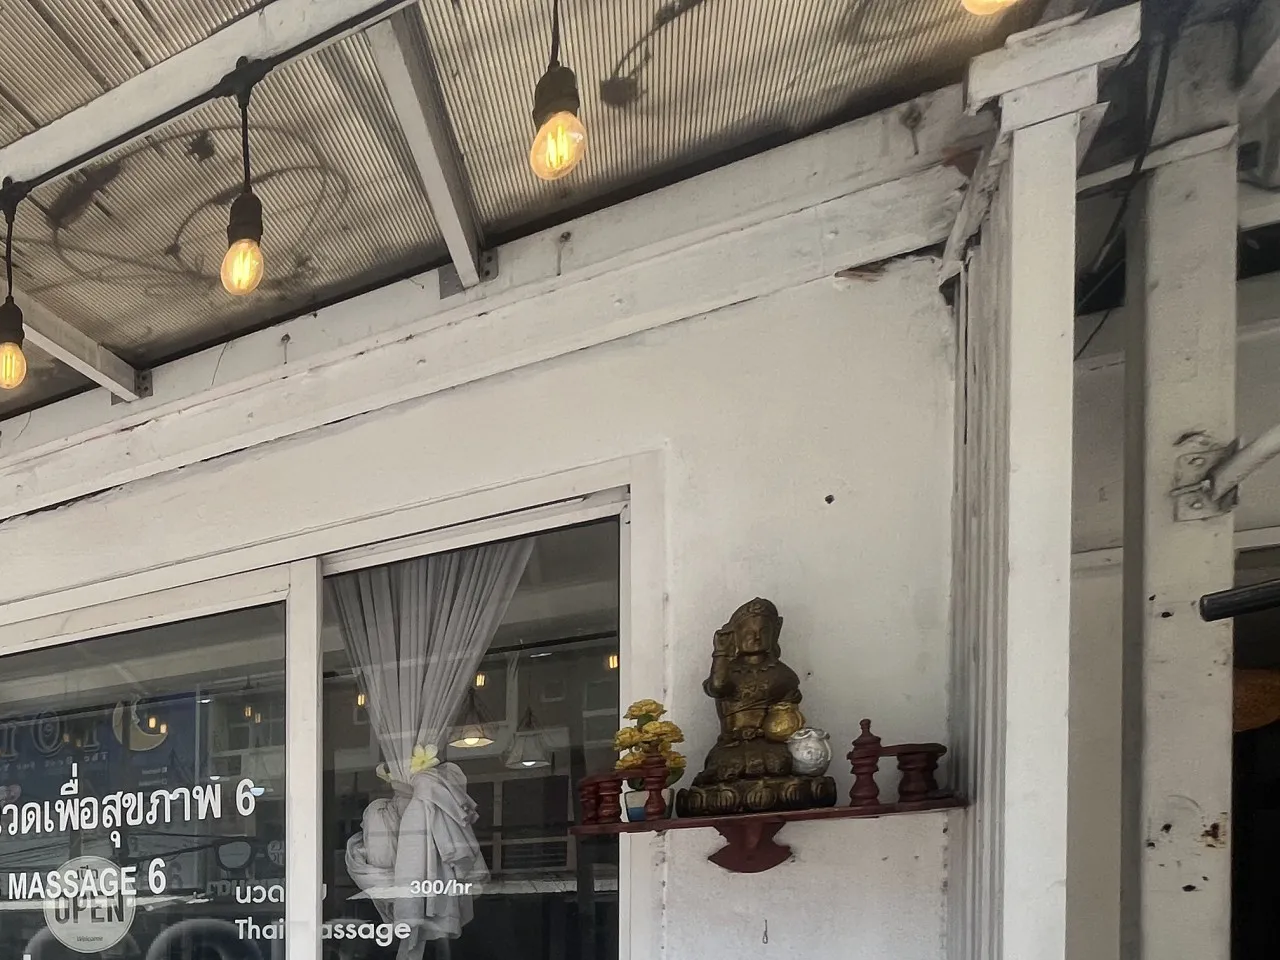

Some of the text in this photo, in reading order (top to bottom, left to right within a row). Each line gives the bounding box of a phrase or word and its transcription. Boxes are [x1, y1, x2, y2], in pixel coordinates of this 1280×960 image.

[235, 778, 256, 817] 6
[7, 865, 137, 901] MASSAGE
[148, 857, 167, 895] 6
[410, 879, 473, 896] 300/hr
[54, 889, 124, 924] OPEN
[234, 918, 412, 947] Thai assage
